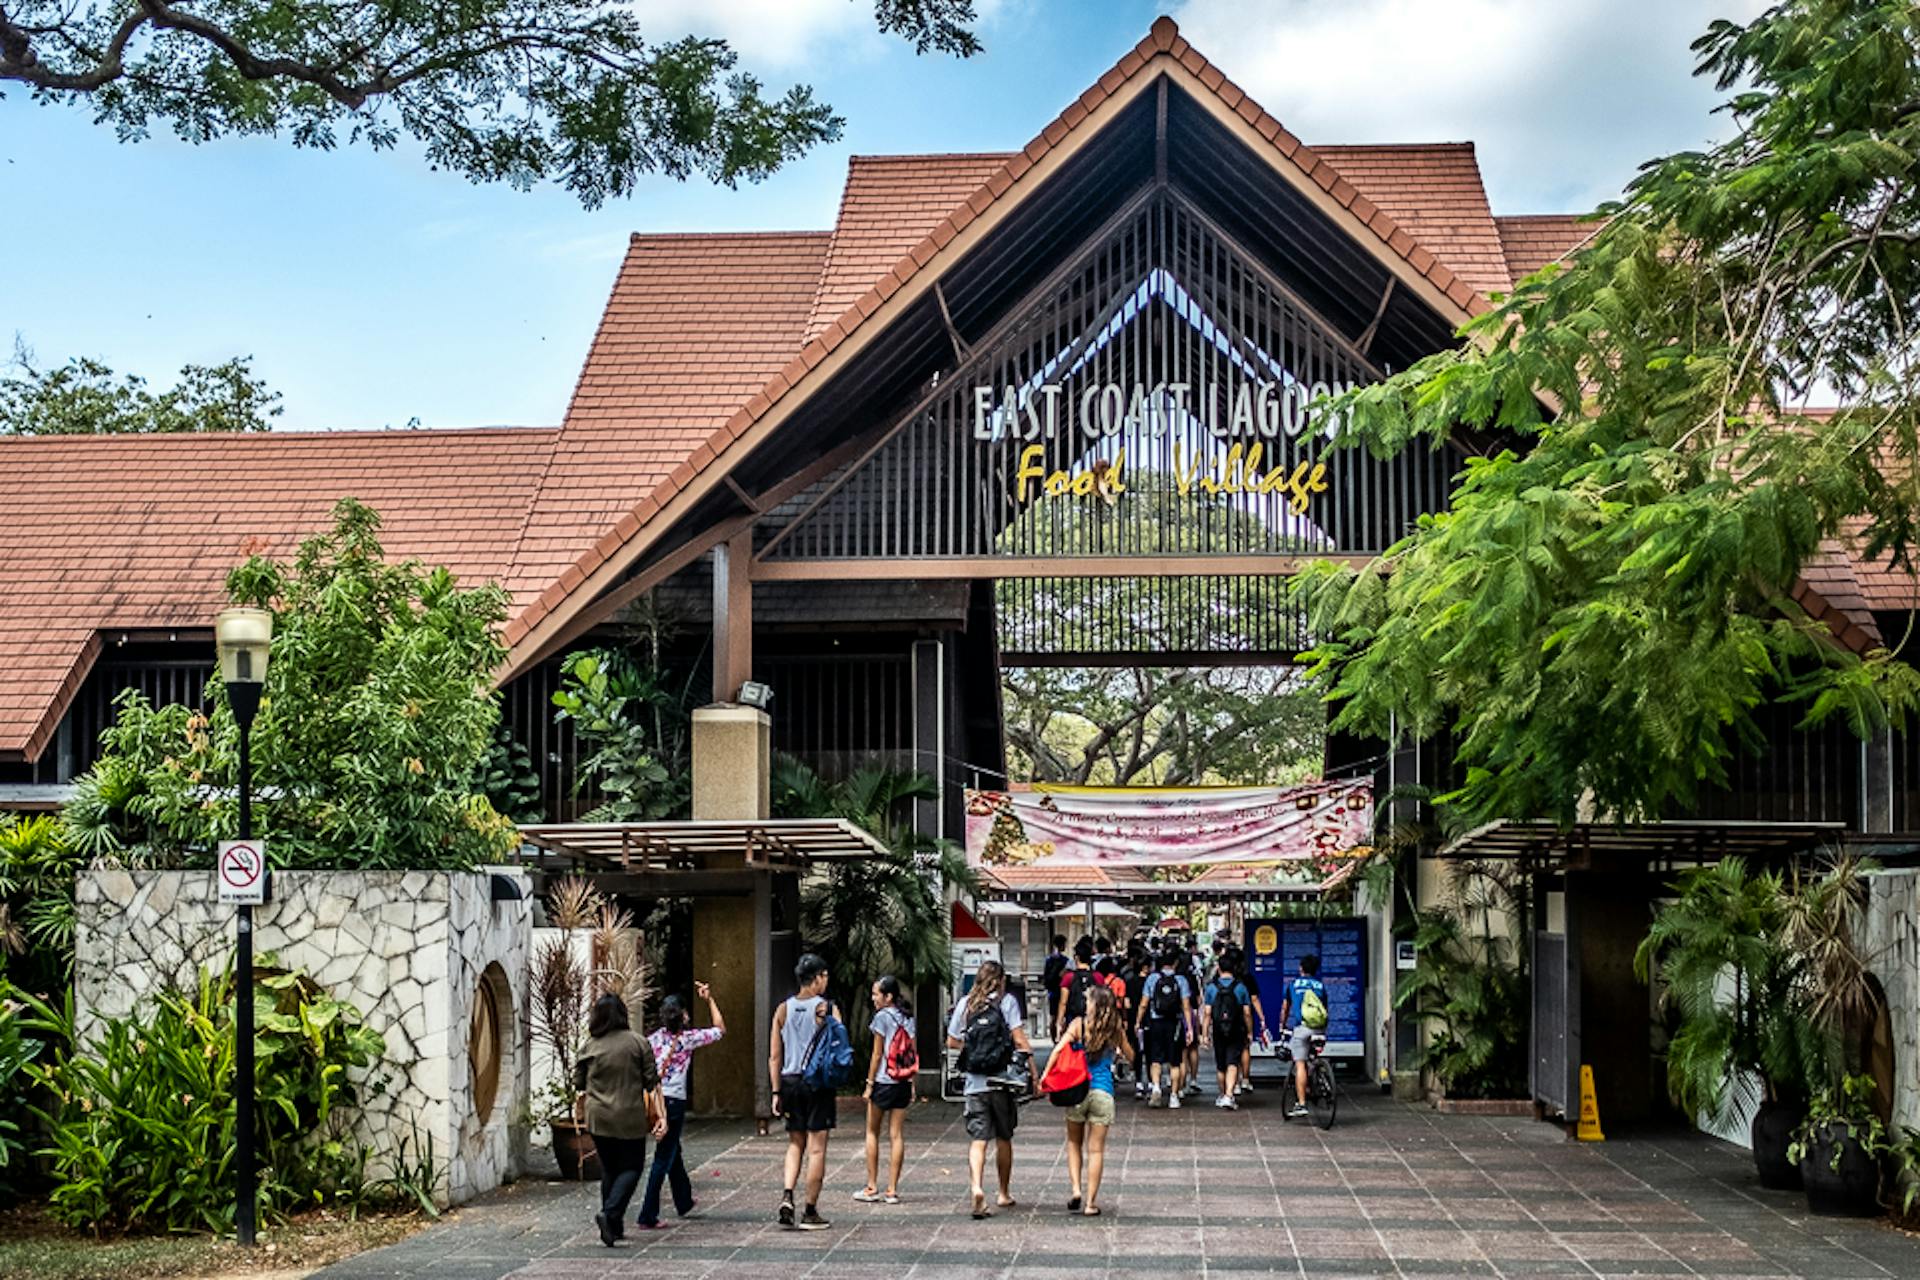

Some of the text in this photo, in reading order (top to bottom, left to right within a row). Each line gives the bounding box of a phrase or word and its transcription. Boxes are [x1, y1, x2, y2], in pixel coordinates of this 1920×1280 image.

[974, 384, 1062, 440] EAST
[1080, 382, 1191, 438] COAST
[1016, 442, 1328, 516] Food Village
